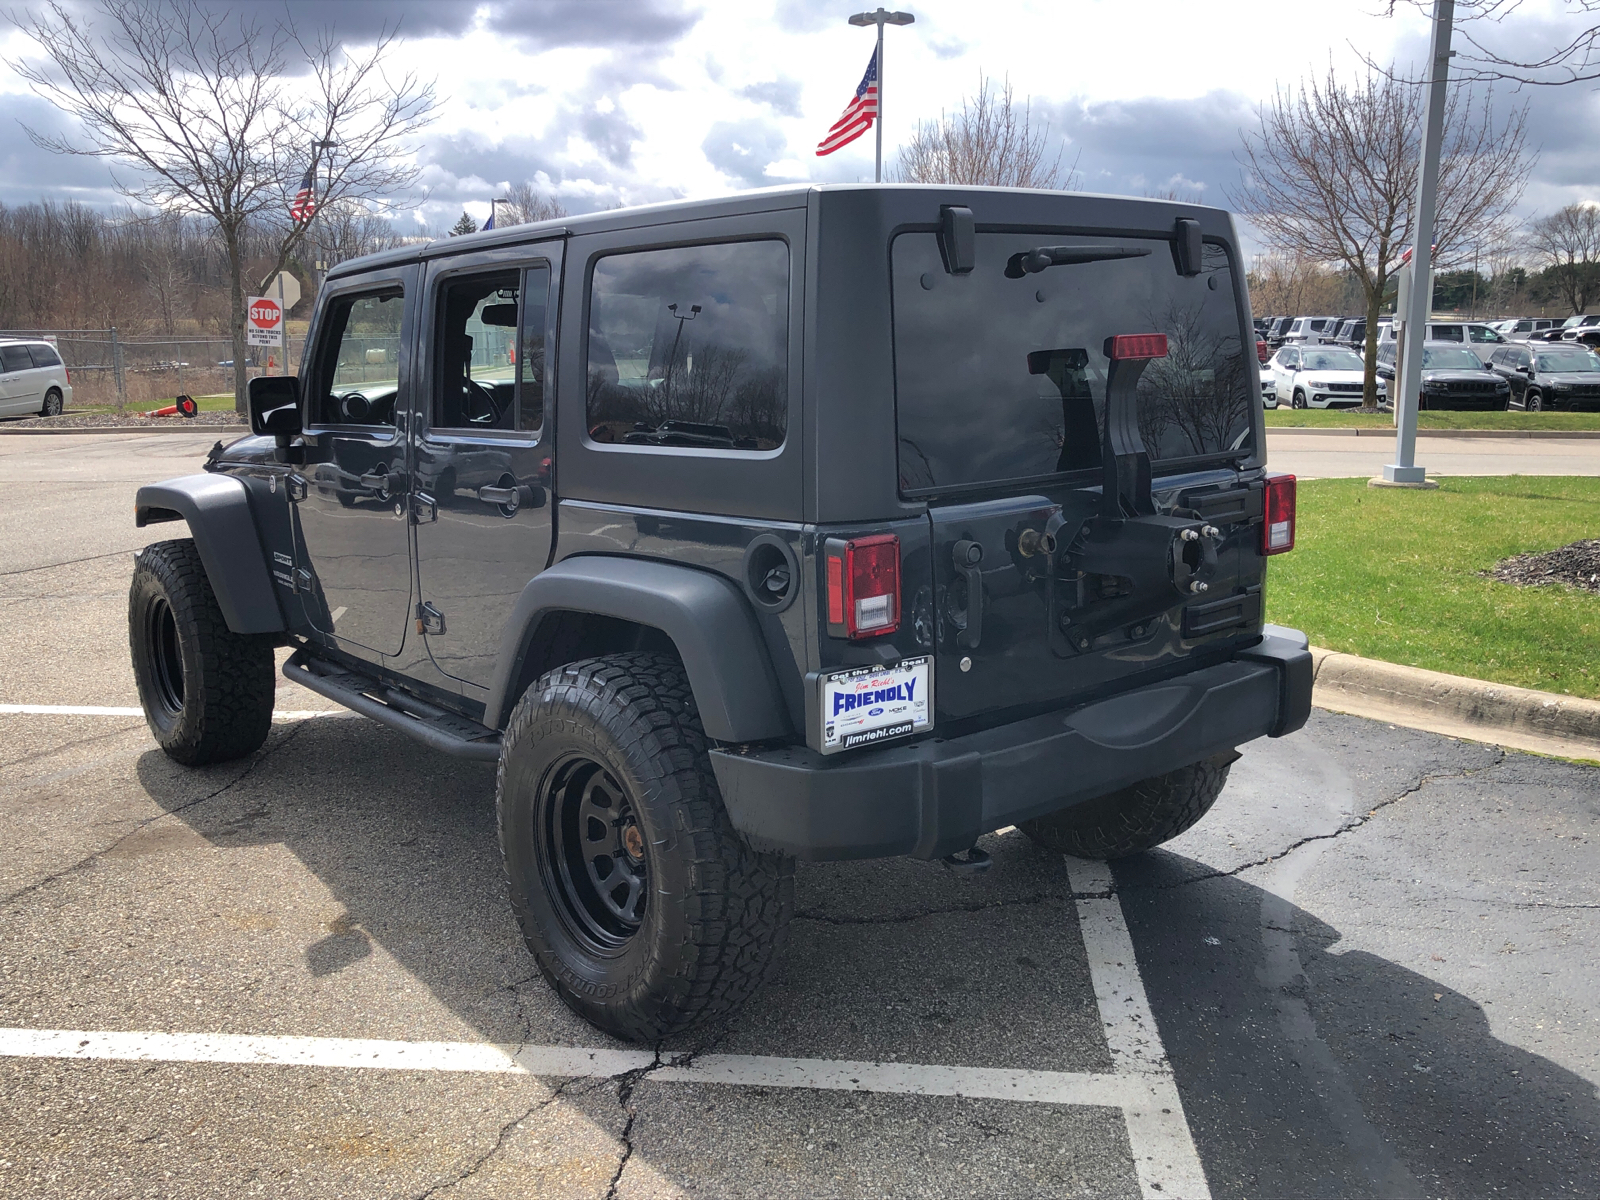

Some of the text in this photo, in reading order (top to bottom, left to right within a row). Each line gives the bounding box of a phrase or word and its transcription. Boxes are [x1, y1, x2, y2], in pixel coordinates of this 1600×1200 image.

[251, 307, 280, 321] STOP
[901, 658, 925, 667] Deal
[855, 677, 895, 694] Jim Riehl's
[833, 676, 917, 717] FRIENDLY
[845, 724, 912, 747] jimriehl.com
